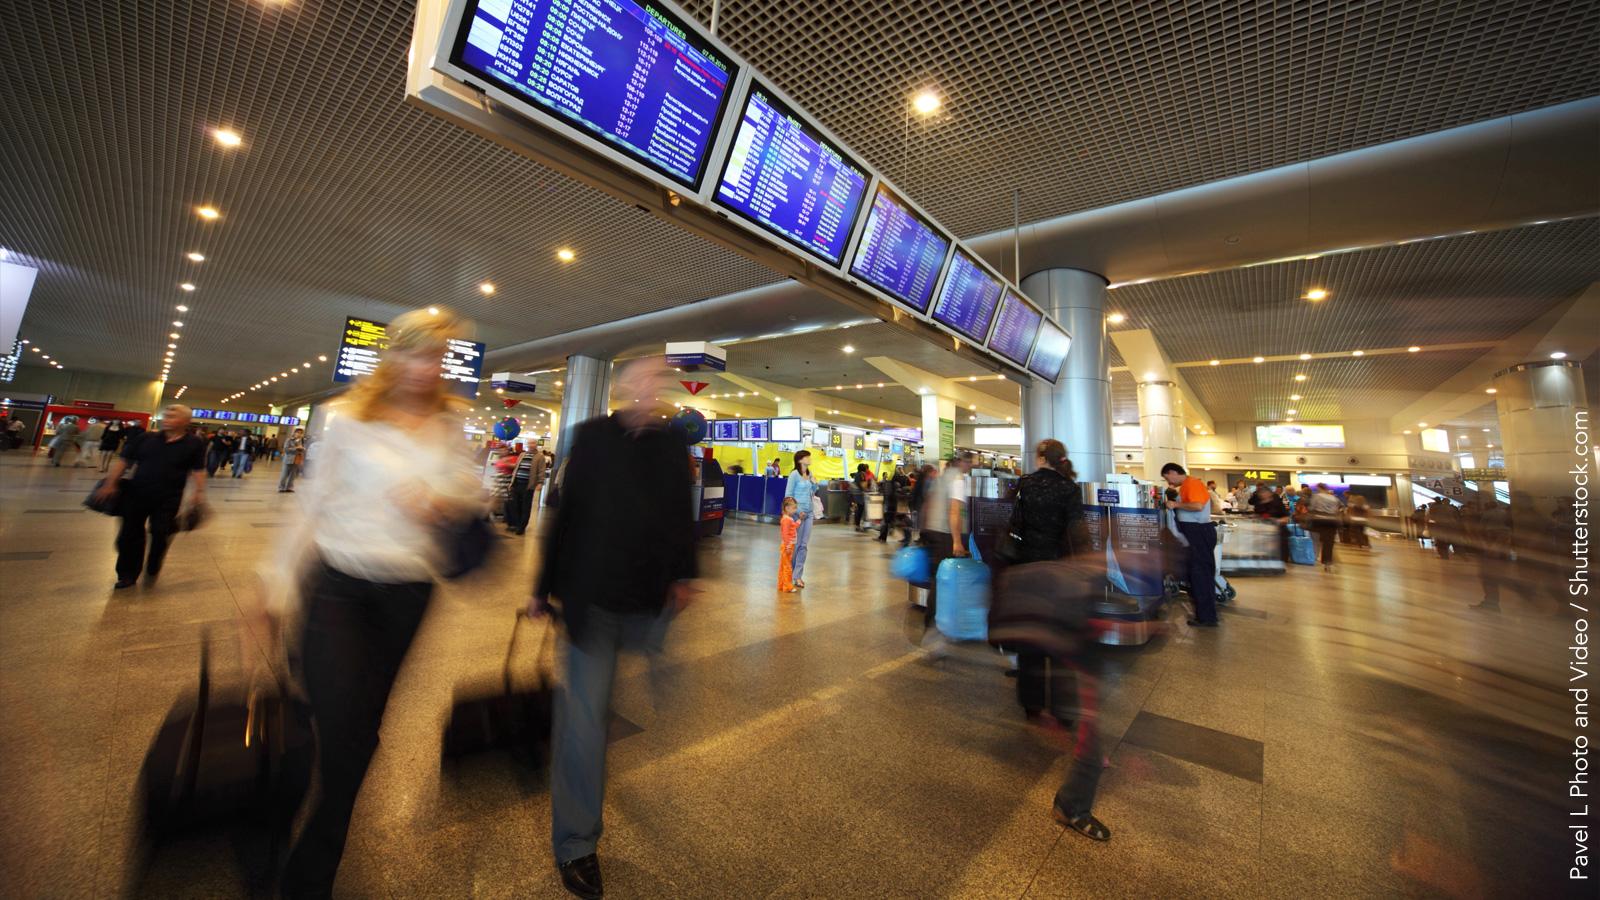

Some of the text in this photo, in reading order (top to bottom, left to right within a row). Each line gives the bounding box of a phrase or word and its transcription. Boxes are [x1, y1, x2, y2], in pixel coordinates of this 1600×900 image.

[645, 3, 686, 40] DEPARTURES
[547, 80, 583, 106] ВОЛГОГРАД
[550, 72, 579, 93] САРАТОВ
[545, 88, 581, 113] ВОЛГОГРАД
